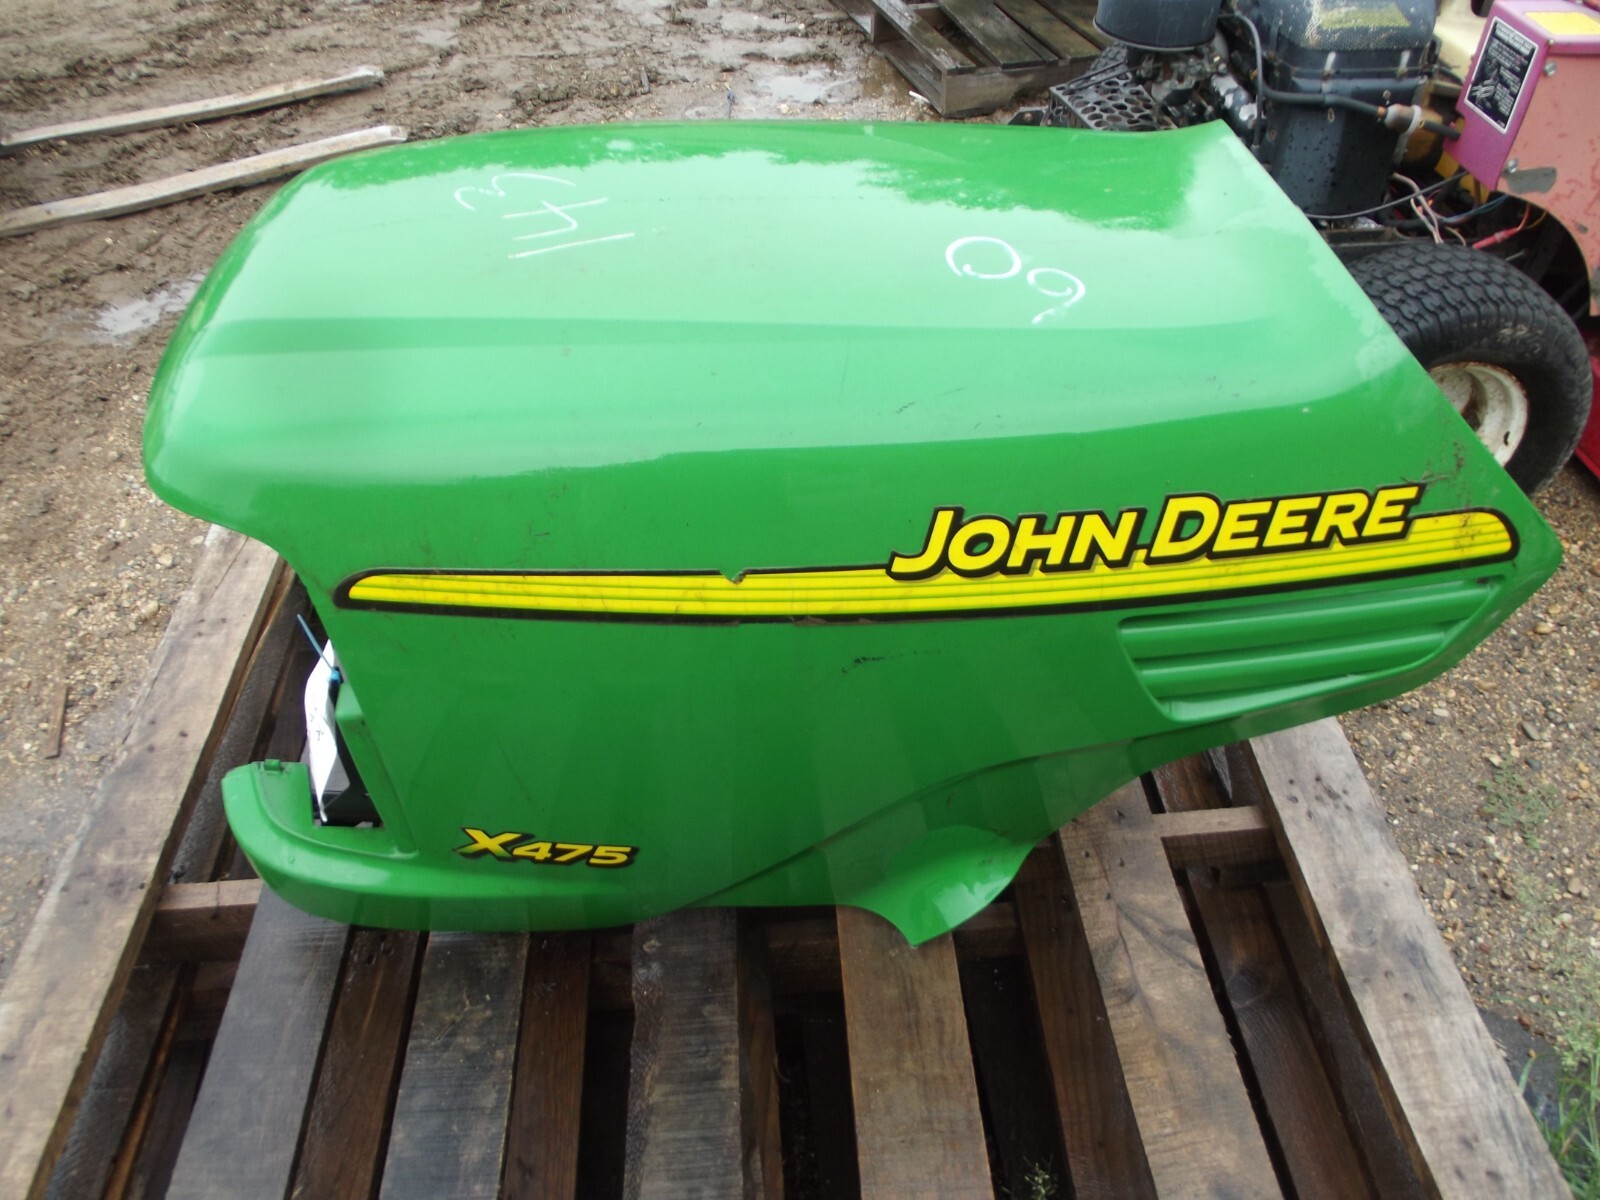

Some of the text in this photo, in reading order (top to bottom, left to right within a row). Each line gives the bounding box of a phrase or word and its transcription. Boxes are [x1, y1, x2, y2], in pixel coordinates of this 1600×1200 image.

[890, 484, 1423, 577] JOHN DEERE
[454, 827, 636, 867] X475
